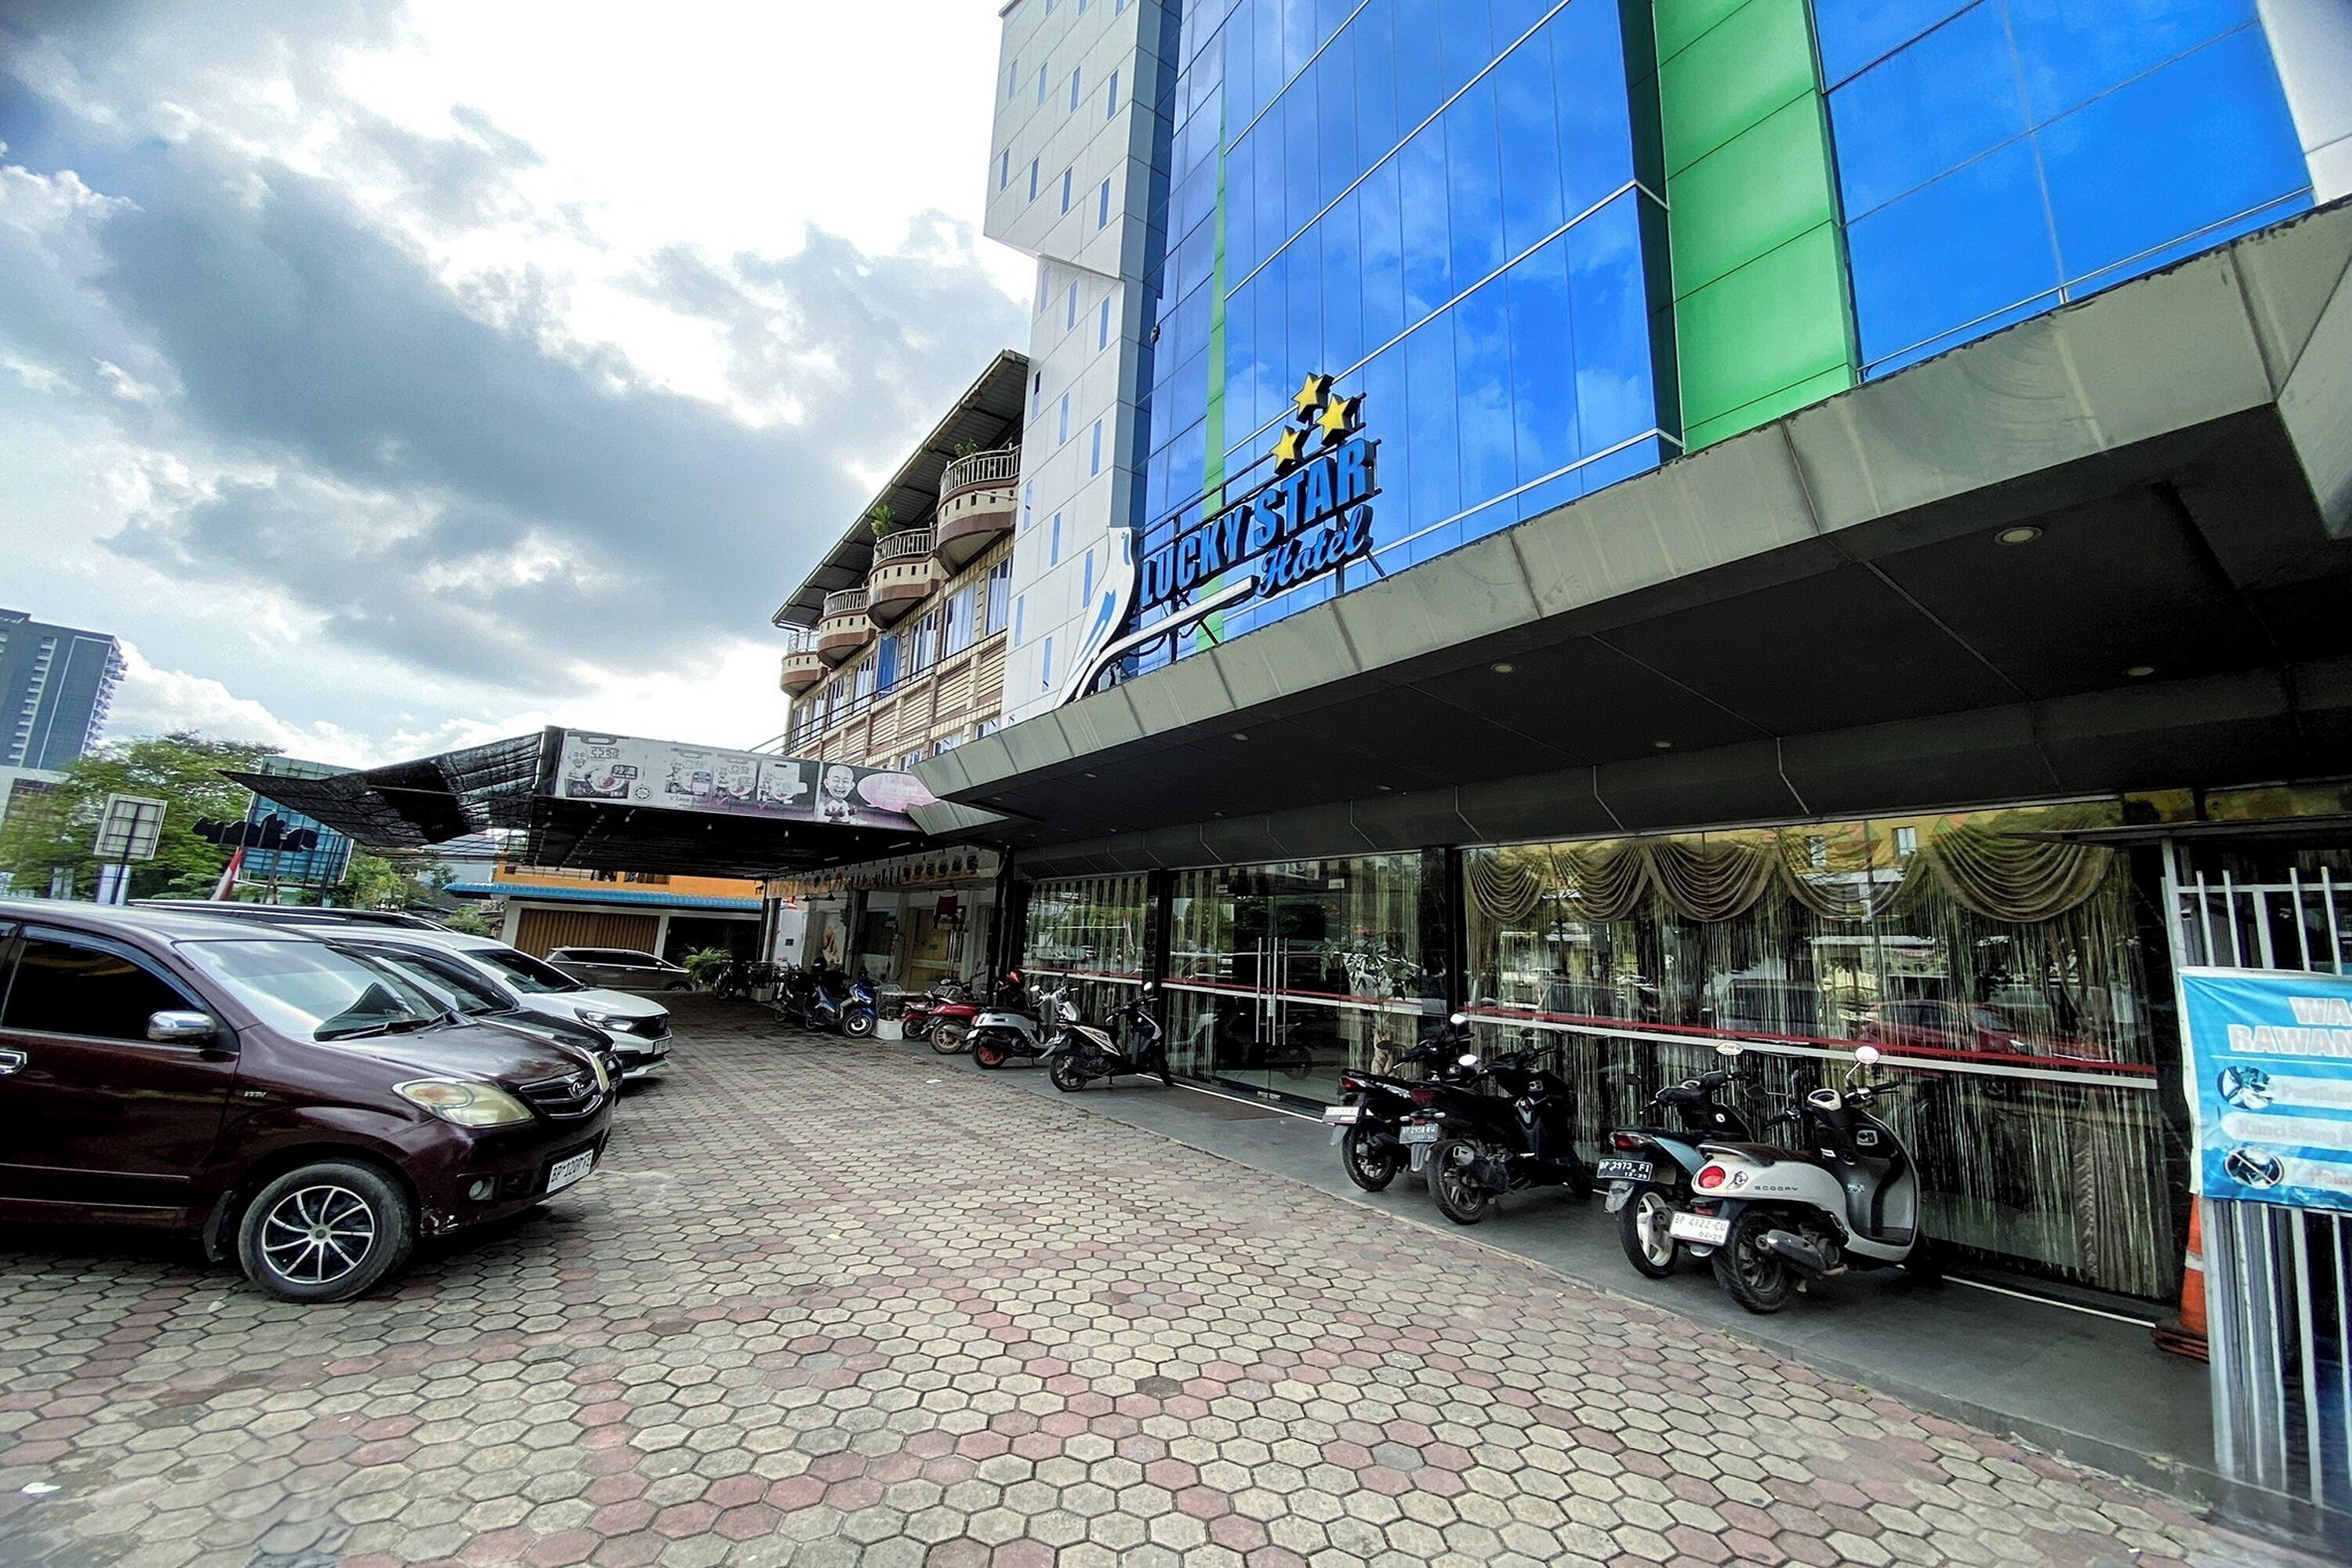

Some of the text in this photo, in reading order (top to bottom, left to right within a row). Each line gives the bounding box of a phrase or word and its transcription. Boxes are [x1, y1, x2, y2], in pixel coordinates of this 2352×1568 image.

[1141, 437, 1370, 608] LUCKY STAR
[1257, 504, 1370, 597] Hotel
[2288, 996, 2352, 1026] WA
[551, 1165, 562, 1182] BP
[1599, 1161, 1610, 1170] BP
[1612, 1161, 1632, 1171] 3973
[1675, 1214, 1686, 1225] BP
